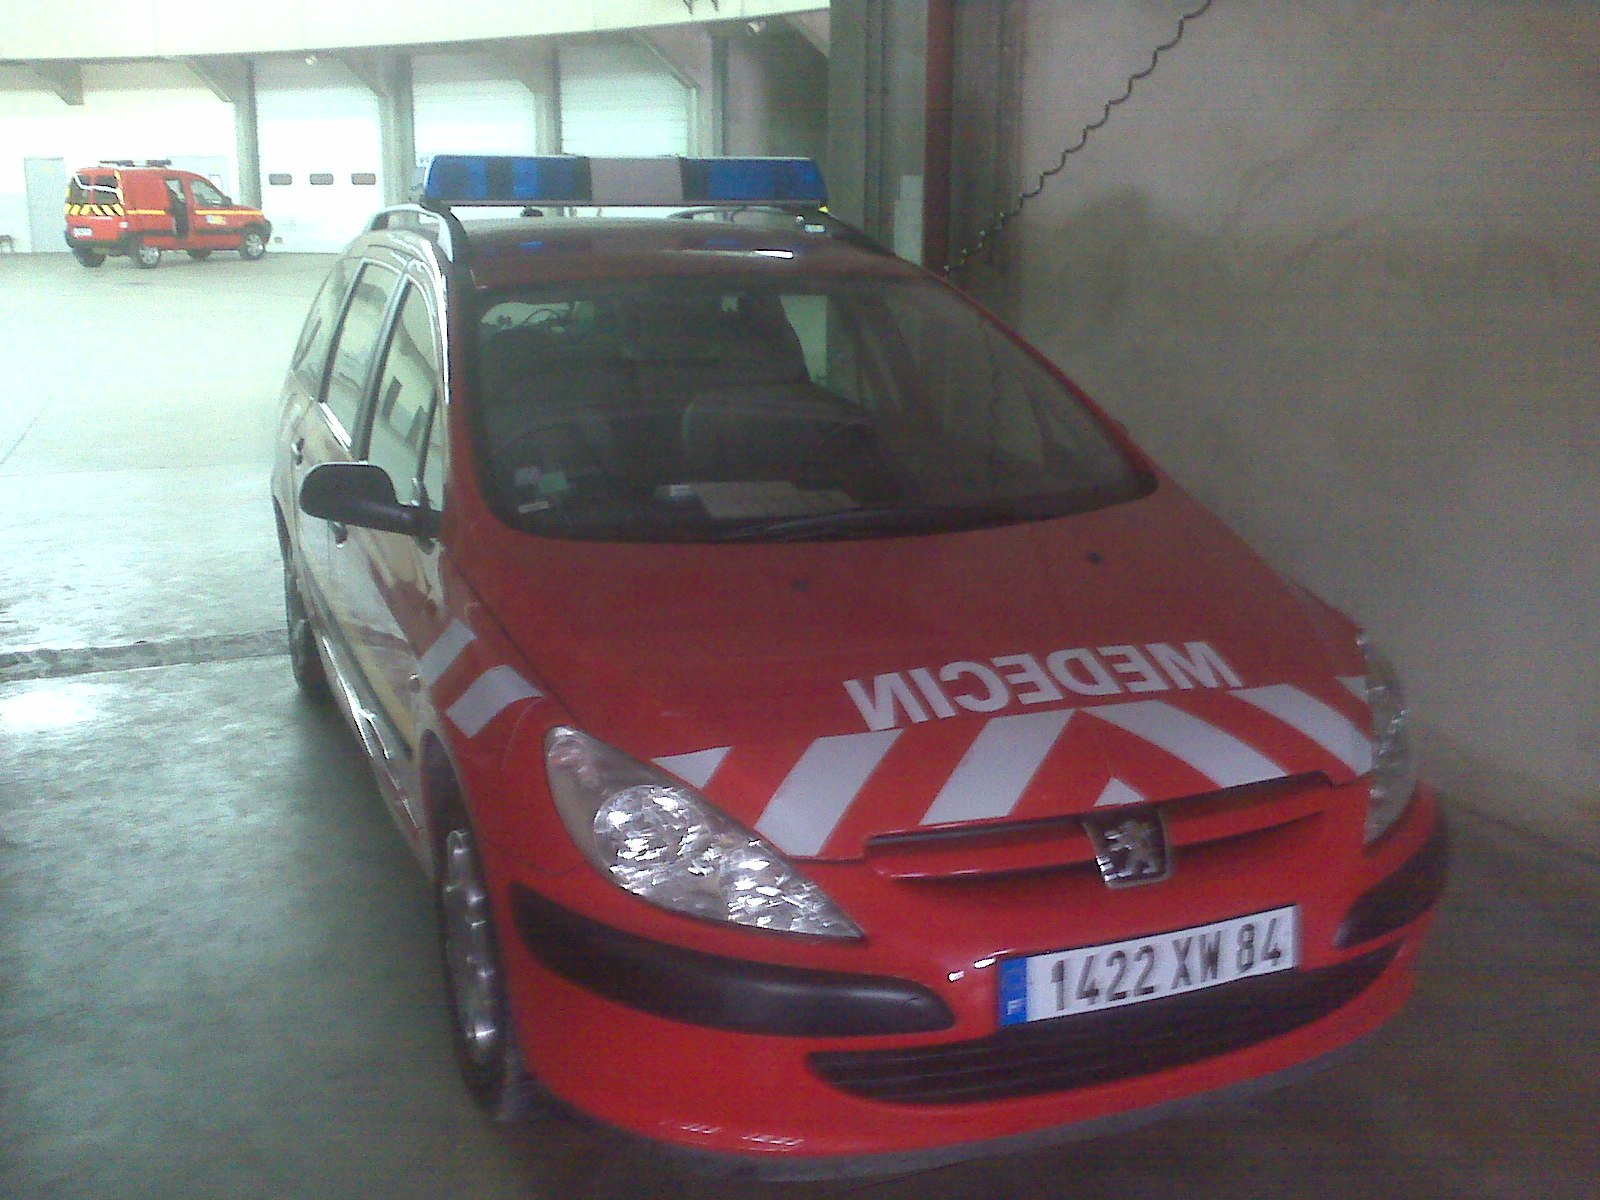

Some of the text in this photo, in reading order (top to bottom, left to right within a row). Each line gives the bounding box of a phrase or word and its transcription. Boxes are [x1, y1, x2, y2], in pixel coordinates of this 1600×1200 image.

[1050, 918, 1281, 1011] 1422 XW 84
[1006, 1000, 1021, 1015] F
